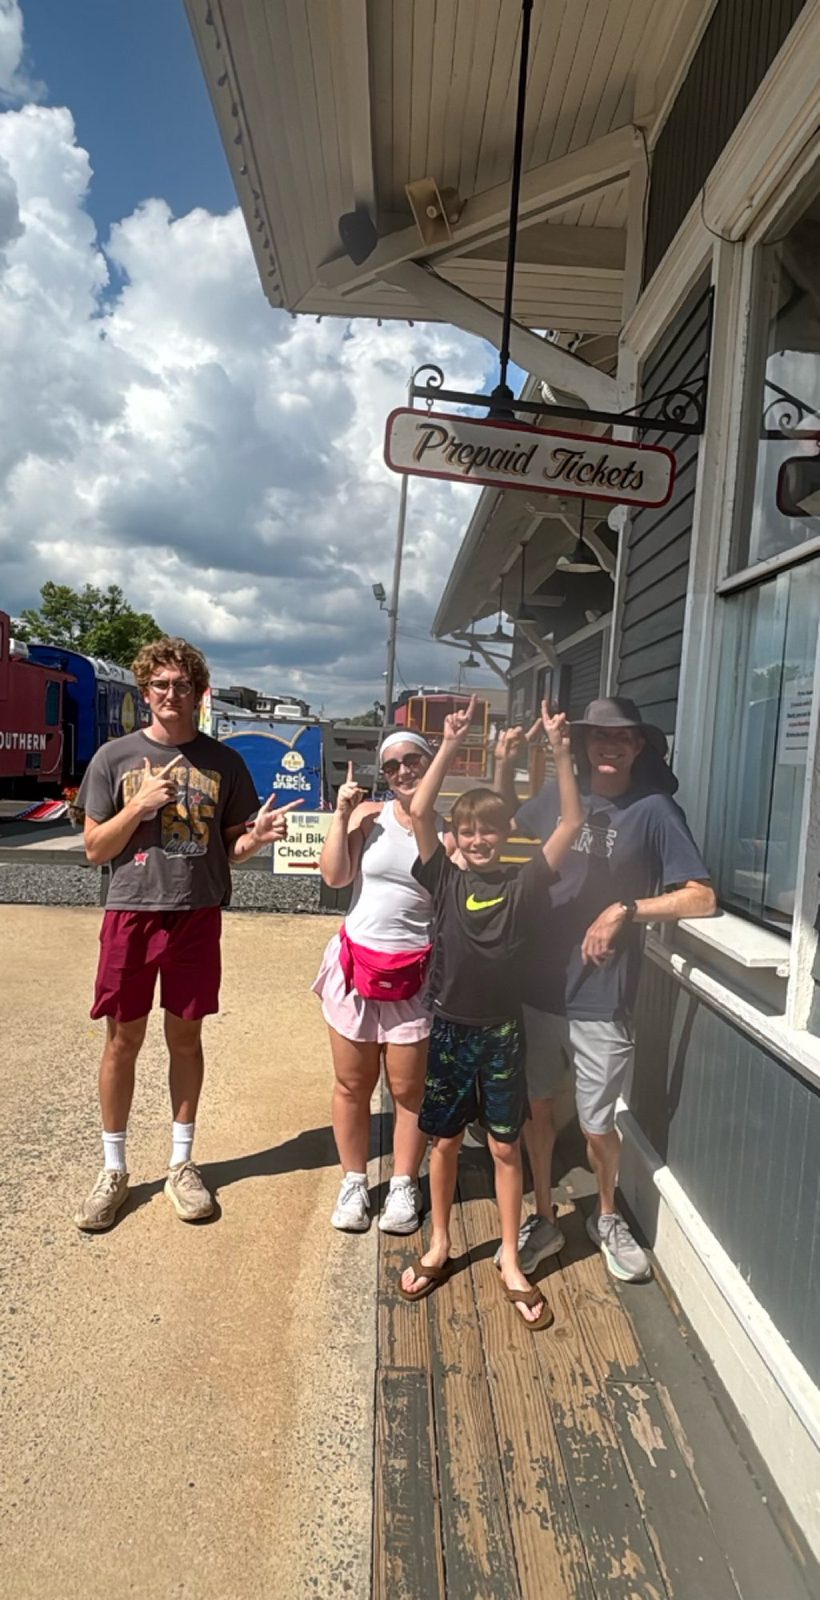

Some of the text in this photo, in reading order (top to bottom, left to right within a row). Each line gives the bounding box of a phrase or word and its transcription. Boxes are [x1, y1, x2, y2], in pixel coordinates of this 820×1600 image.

[415, 424, 643, 491] Prepaid Tickets
[275, 773, 306, 782] track
[273, 781, 311, 791] snacks
[306, 833, 326, 843] Bik
